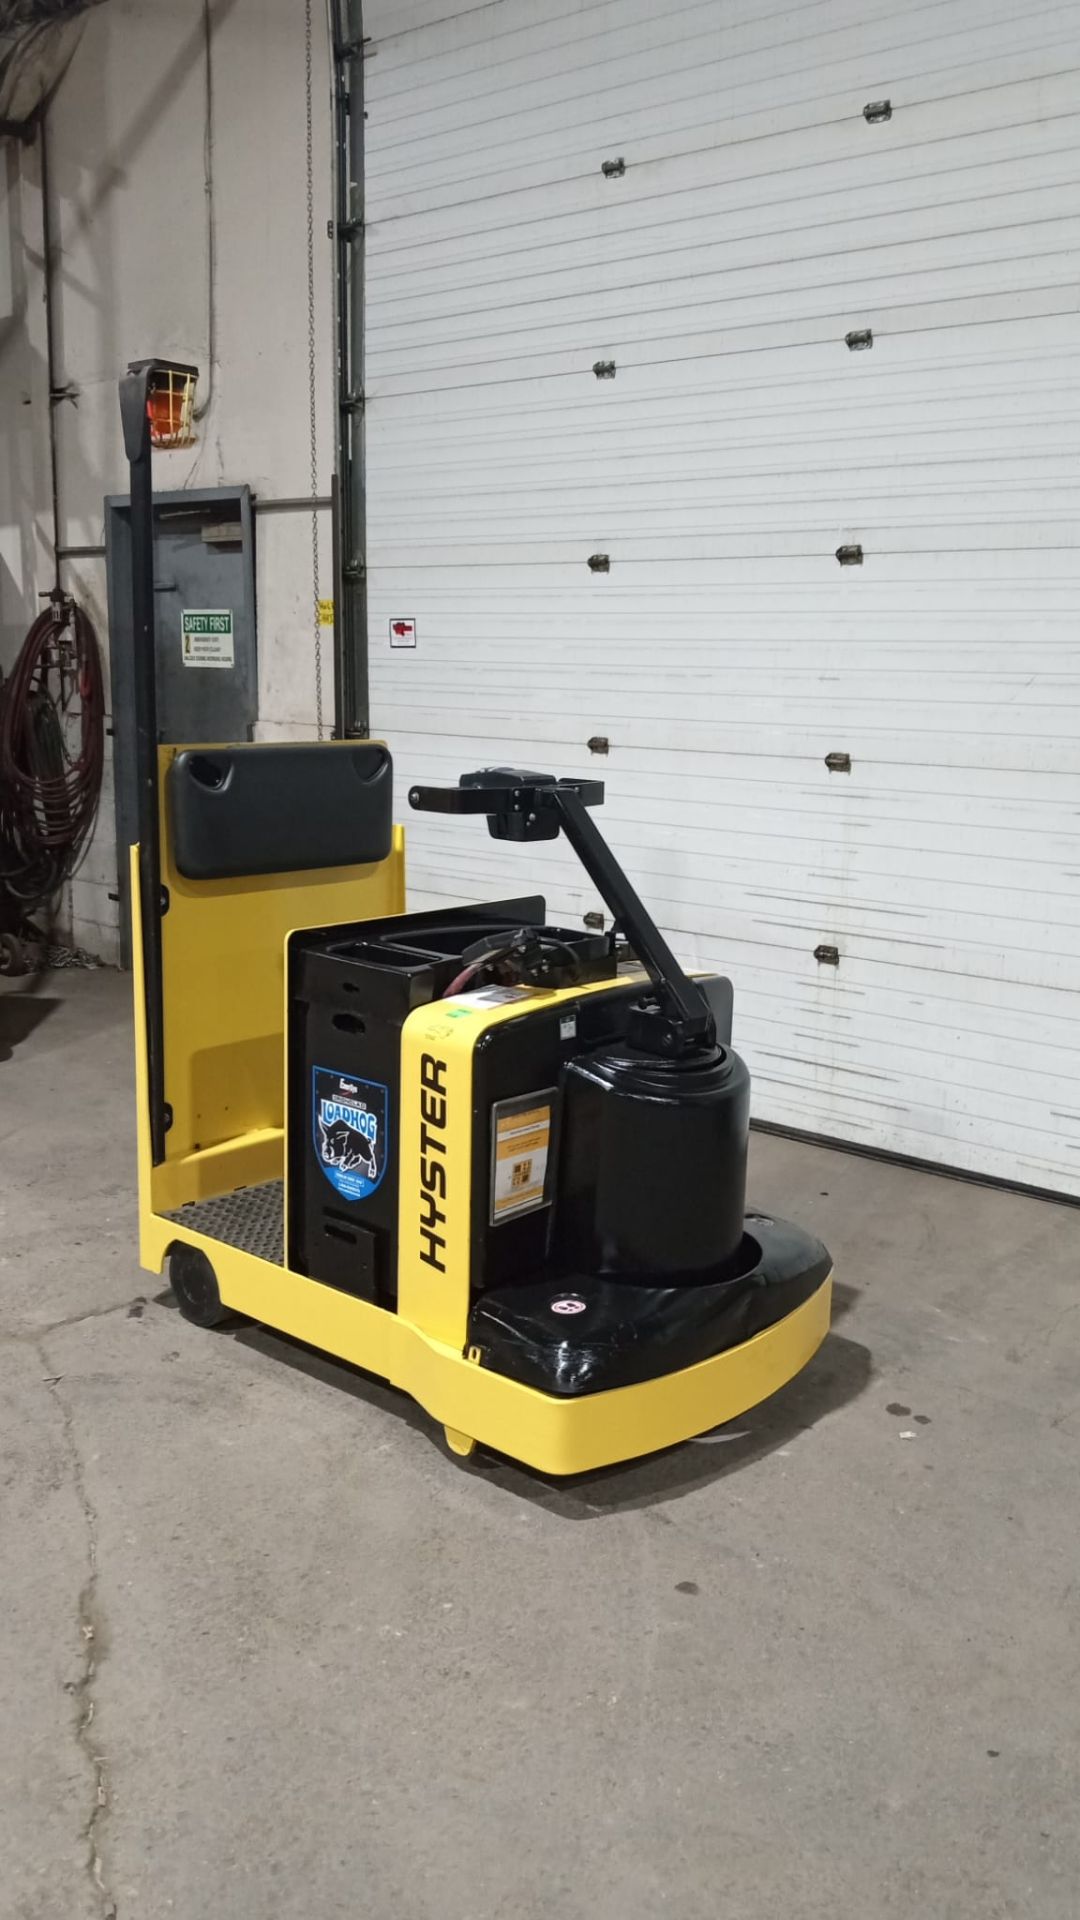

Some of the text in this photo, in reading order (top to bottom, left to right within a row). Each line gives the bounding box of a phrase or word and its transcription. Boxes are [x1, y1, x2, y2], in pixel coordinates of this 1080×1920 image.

[185, 616, 230, 631] SAFETY FIRST
[321, 1099, 377, 1142] LOADHOG
[420, 1053, 447, 1274] HYSTER
